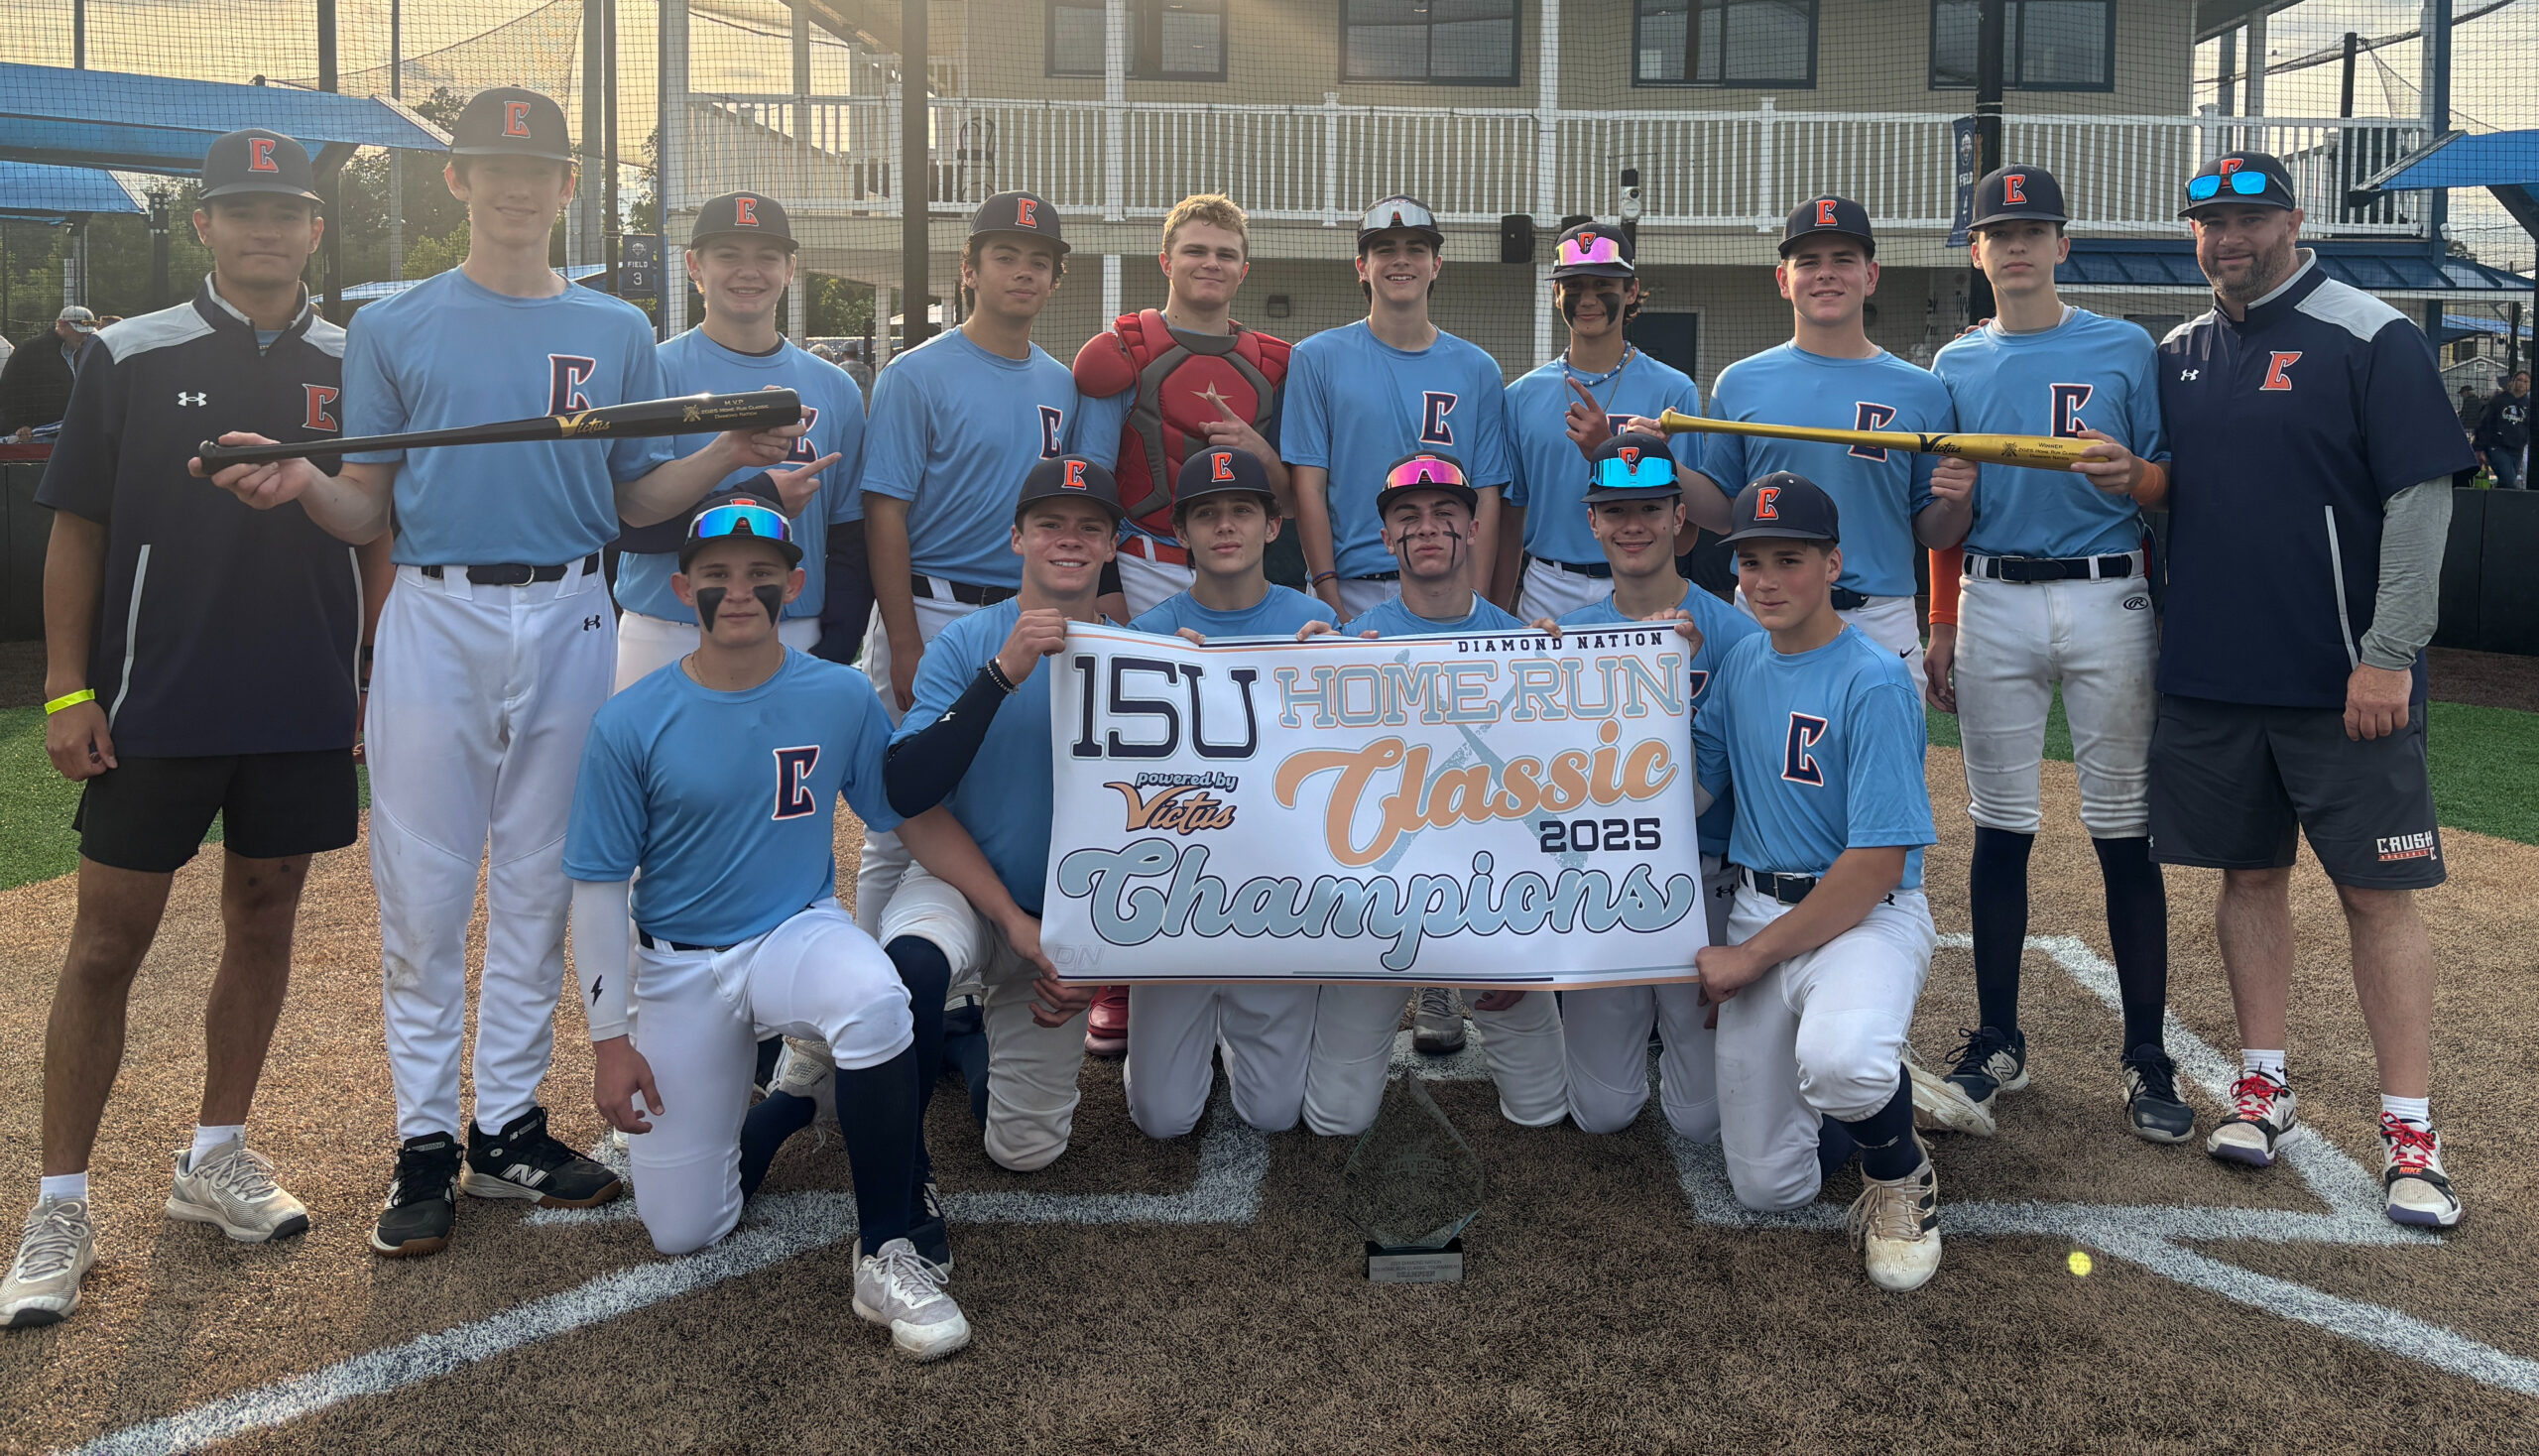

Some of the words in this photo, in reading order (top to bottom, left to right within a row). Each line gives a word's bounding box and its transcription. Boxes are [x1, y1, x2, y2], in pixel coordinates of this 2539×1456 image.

[501, 101, 531, 138] C
[248, 138, 279, 173] C
[2003, 175, 2026, 206] C
[735, 197, 759, 227] C
[1015, 198, 1037, 229] C
[1815, 199, 1838, 226] C
[633, 272, 643, 286] 3
[553, 408, 610, 437] Victus
[1419, 391, 1458, 445] C
[1917, 433, 1962, 453] Victus
[1061, 460, 1087, 490] C
[1211, 452, 1236, 483] C
[1753, 487, 1781, 521] C
[1458, 637, 1563, 653] DIAMOND
[1577, 632, 1663, 650] NATION
[1273, 660, 1501, 729] HOME
[1510, 653, 1684, 721] RUN
[1070, 653, 1260, 762] 15U
[1781, 711, 1828, 788] C
[772, 744, 820, 821] C
[1136, 771, 1214, 789] powered
[1214, 771, 1239, 792] by
[1272, 717, 1679, 868] Classic
[1103, 782, 1237, 835] Victus
[1539, 817, 1662, 853] 2025
[2376, 830, 2434, 853] CRUSH
[1057, 838, 1695, 971] Champions
